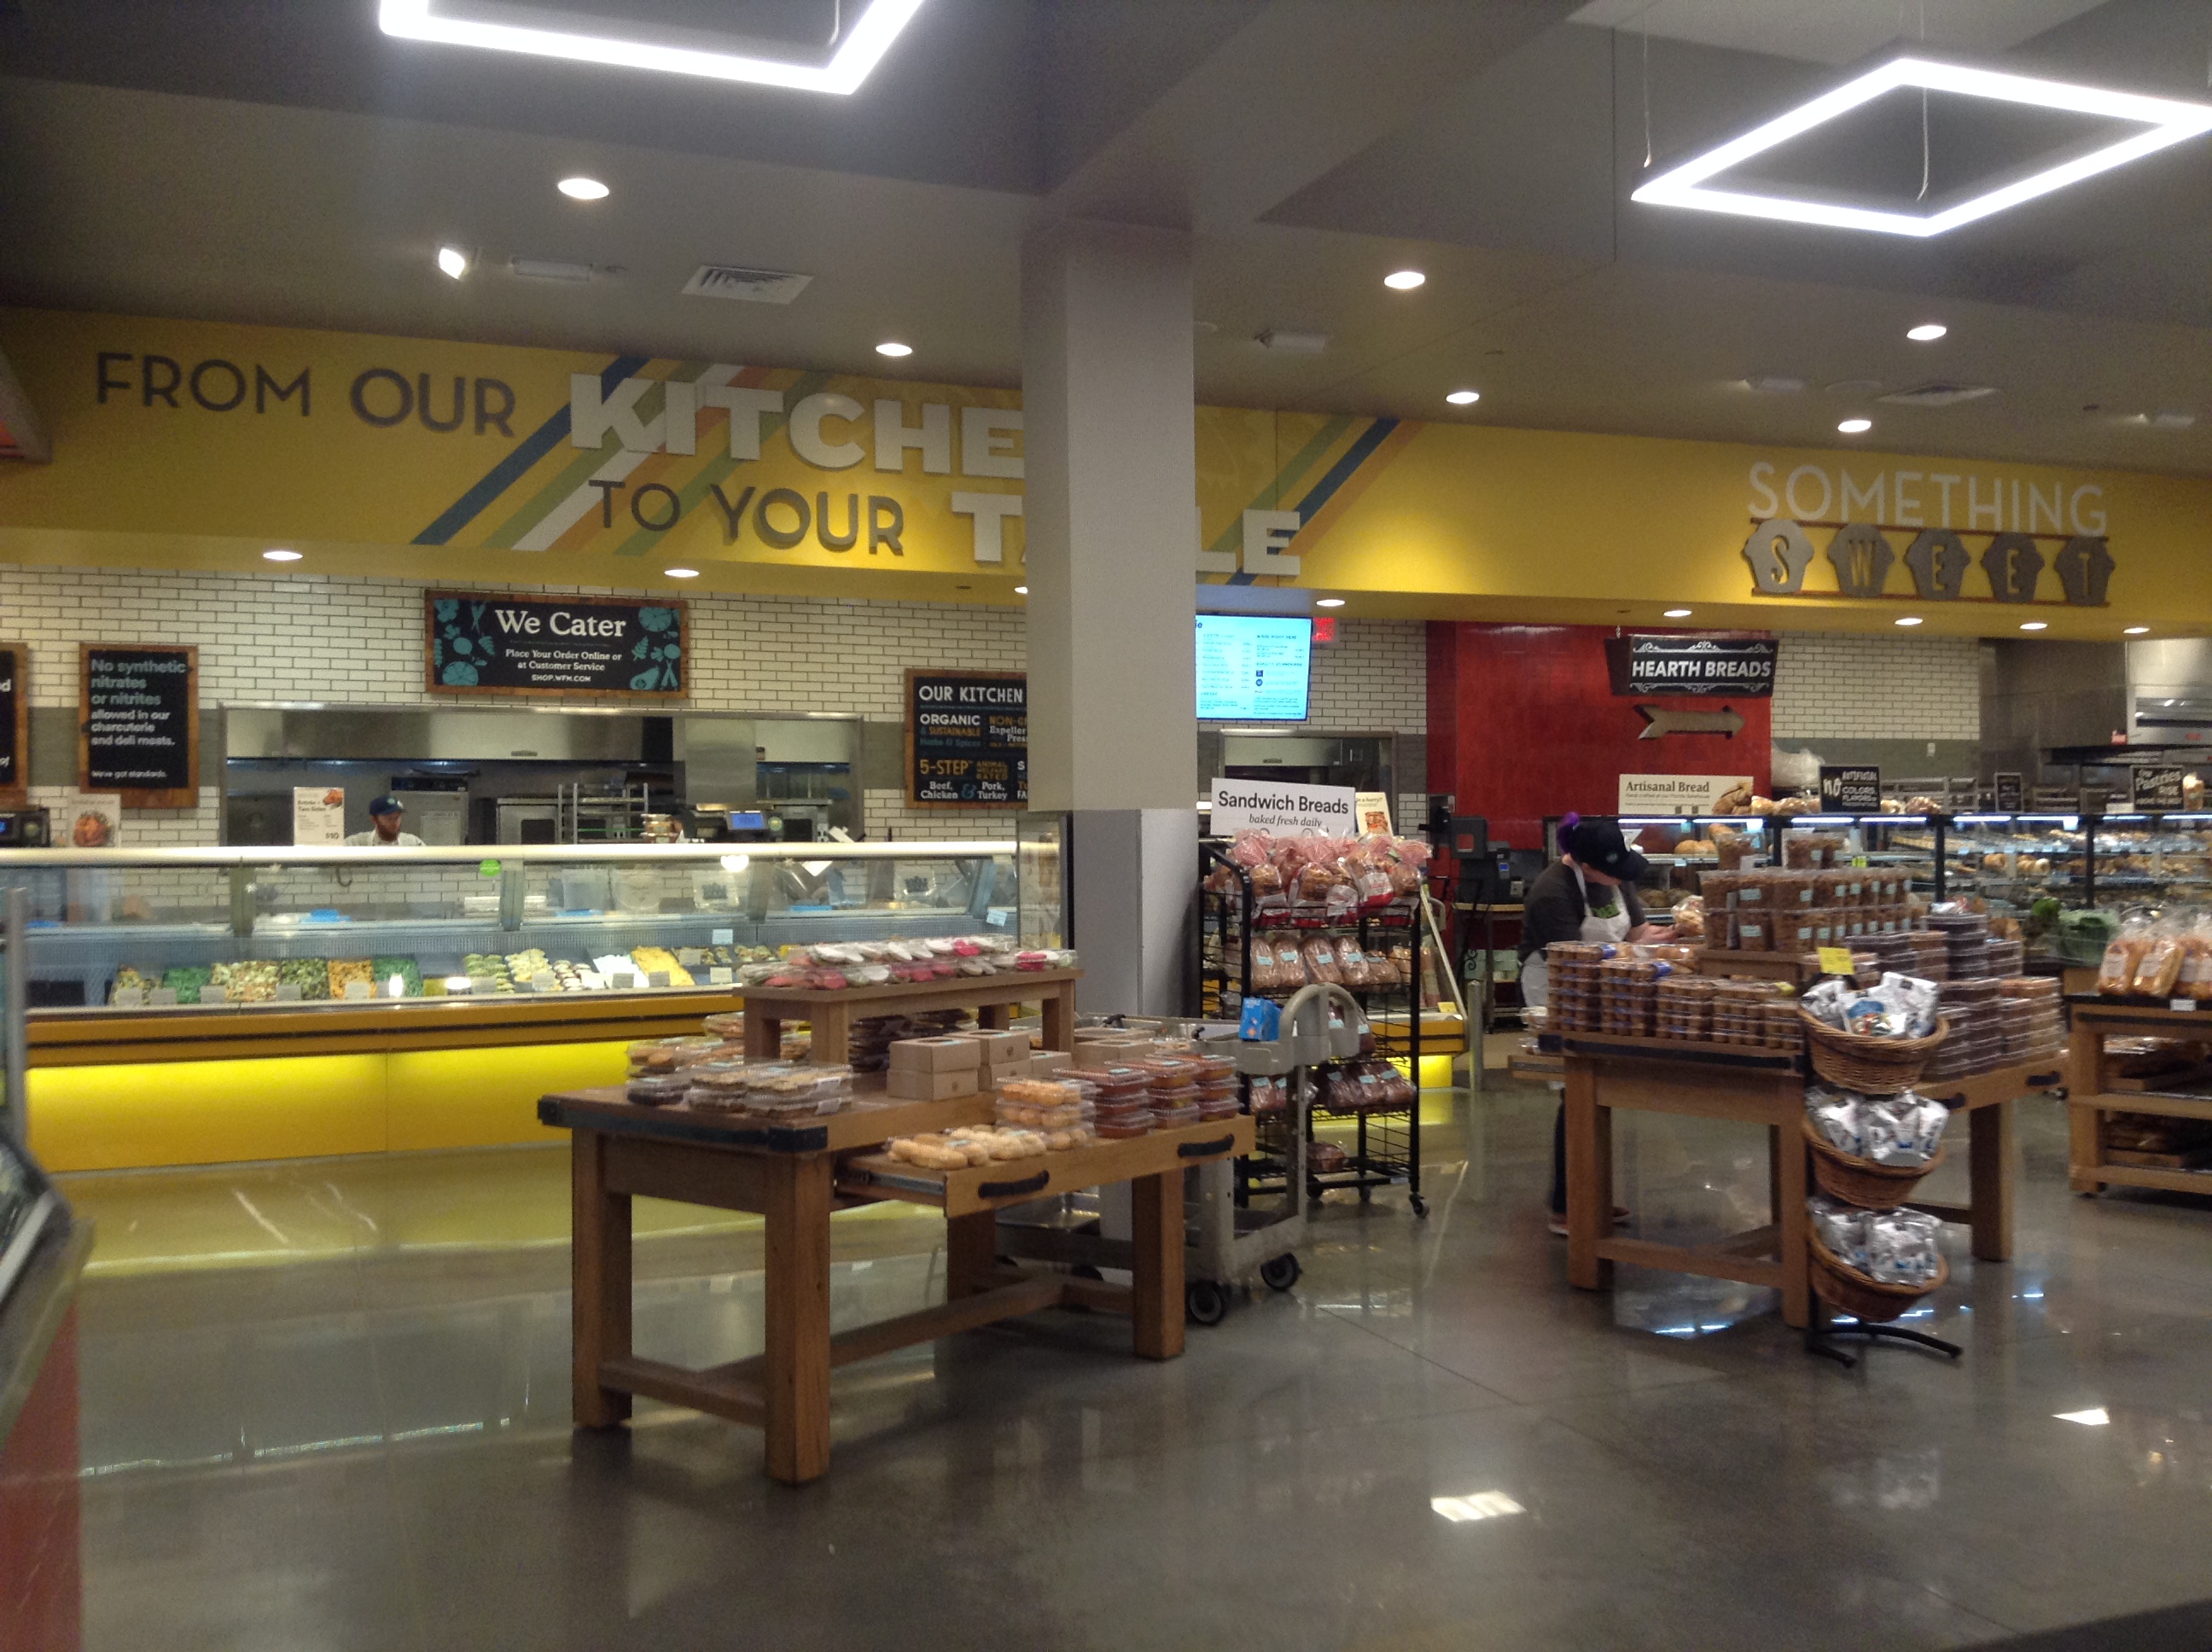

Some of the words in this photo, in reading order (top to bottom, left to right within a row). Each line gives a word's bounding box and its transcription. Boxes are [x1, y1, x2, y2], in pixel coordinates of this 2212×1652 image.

[96, 351, 311, 417] FROM
[349, 367, 517, 437] OUR
[570, 373, 1024, 479] KITCHE
[1747, 462, 2108, 538] SOMETHING
[588, 480, 681, 532] TO
[710, 484, 905, 556] YOUR
[494, 609, 540, 635] We
[549, 611, 626, 637] Cater
[505, 649, 529, 658] Place
[532, 649, 551, 659] Your
[554, 650, 579, 660] Order
[581, 650, 611, 660] Online
[91, 658, 113, 672] No
[118, 660, 187, 674] synthetic
[529, 660, 571, 670] Customer
[573, 661, 605, 671] Service
[1632, 660, 1701, 677] HEARTH
[1704, 661, 1771, 678] BREADS
[91, 676, 147, 689] nitrates
[91, 694, 107, 705] or
[110, 692, 161, 706] nitrites
[918, 685, 953, 701] OUR
[959, 686, 1023, 703] KITCHEN
[90, 709, 135, 720] allowed
[137, 710, 148, 720] in
[150, 712, 171, 721] our
[920, 713, 981, 725] ORGANIC
[988, 715, 1027, 725] NON-G
[989, 725, 1027, 736] Expeller
[90, 735, 113, 746] and
[114, 735, 136, 746] deli
[1007, 733, 1027, 742] Pres
[929, 781, 953, 791] Beef,
[981, 782, 1005, 792] Pork,
[1626, 781, 1675, 792] Artisanal
[1678, 782, 1709, 792] Bread
[921, 790, 958, 800] Chicken
[977, 790, 1008, 800] Turkey
[1218, 790, 1295, 811] Sandwich
[1299, 795, 1349, 814] Breads
[1249, 813, 1275, 824] baked
[1276, 815, 1298, 826] fresh
[1301, 817, 1322, 828] daily
